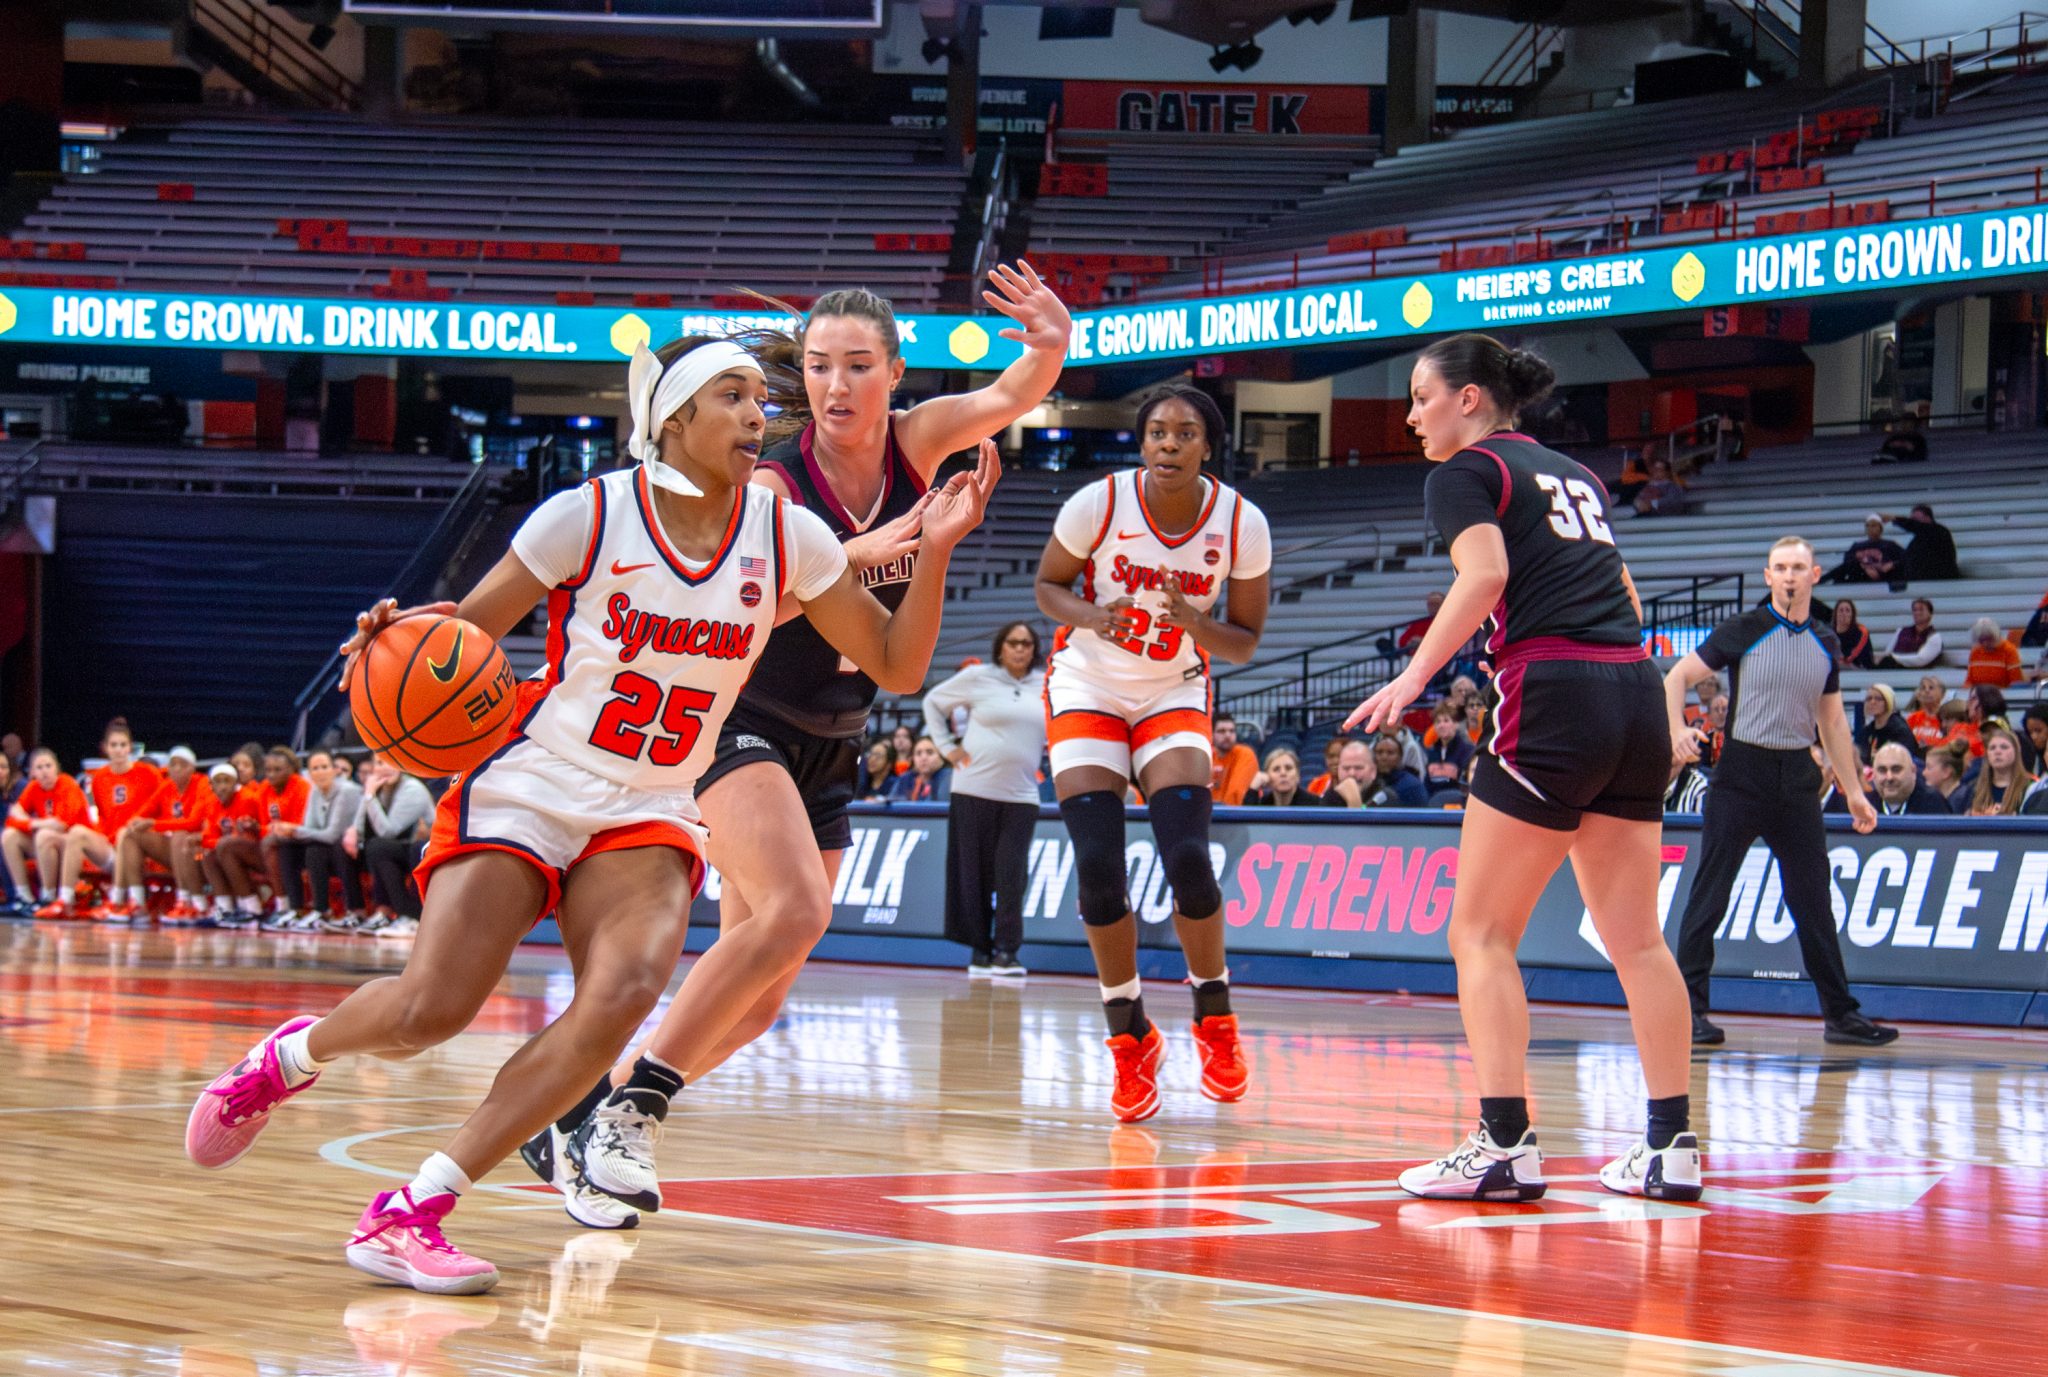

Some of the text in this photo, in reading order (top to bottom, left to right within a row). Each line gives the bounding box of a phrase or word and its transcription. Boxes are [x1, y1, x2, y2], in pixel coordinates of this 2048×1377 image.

[1117, 89, 1308, 134] GATE K
[1456, 258, 1645, 302] MEIER'S CREEK
[1735, 212, 2048, 294] HOME GROWN. DRI
[52, 296, 578, 353] HOME GROWN. DRINK LOCAL.
[1097, 308, 1195, 357] GROWN.
[1199, 298, 1280, 347] DRINK
[1284, 289, 1378, 339] LOCAL.
[1483, 295, 1612, 322] BREWING COMPANY
[1533, 472, 1616, 547] 32
[601, 592, 756, 664] Syracuse
[1113, 606, 1186, 661] 23
[587, 669, 717, 767] 25
[831, 827, 924, 907] ILK
[1226, 842, 1459, 935] STRENG
